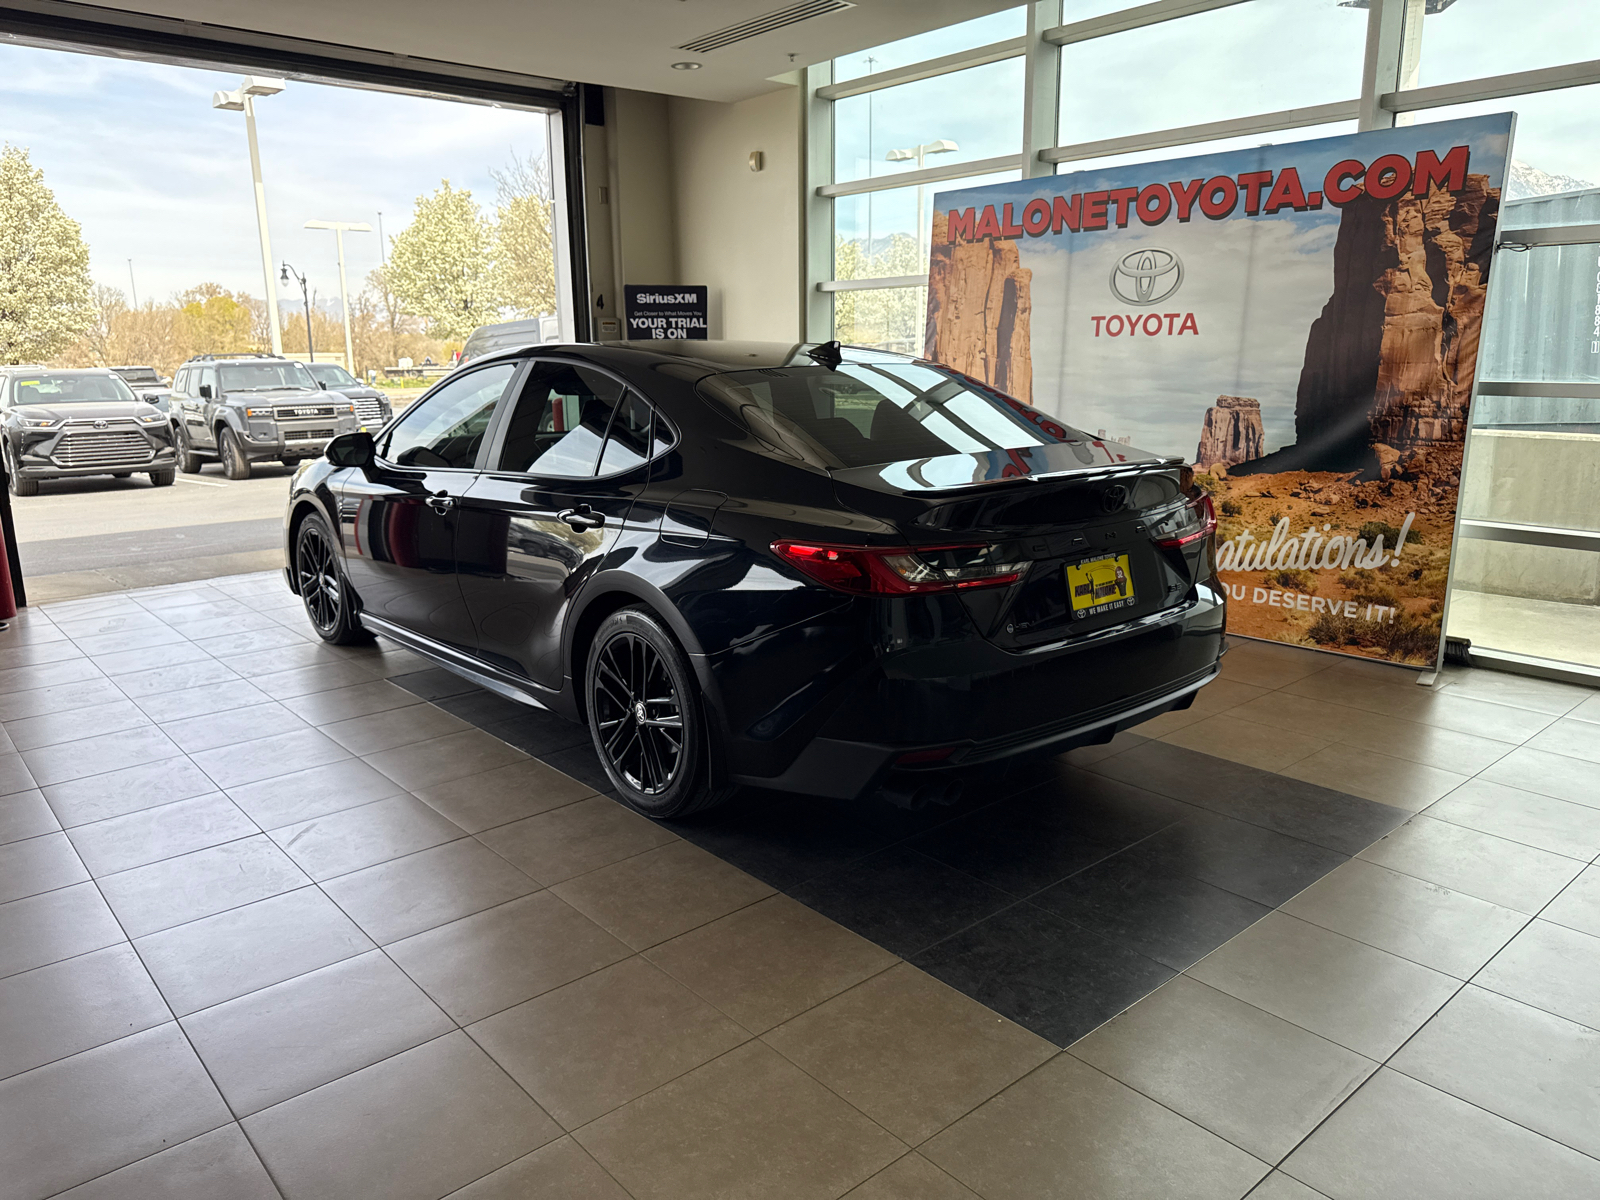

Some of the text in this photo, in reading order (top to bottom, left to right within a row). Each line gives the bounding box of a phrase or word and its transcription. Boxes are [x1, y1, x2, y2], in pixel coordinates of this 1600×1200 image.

[947, 145, 1471, 244] MALONETOYOTA.COM
[596, 294, 604, 310] 4
[636, 293, 697, 304] SiriusXM
[630, 318, 707, 329] YOUR TRIAL
[1091, 311, 1200, 338] TOYOTA
[652, 329, 687, 339] IS ON
[1216, 512, 1415, 572] atulations!
[1088, 600, 1124, 615] WE MAKE IT EASY
[1253, 588, 1357, 619] DESERVE
[1365, 604, 1395, 625] IT!
